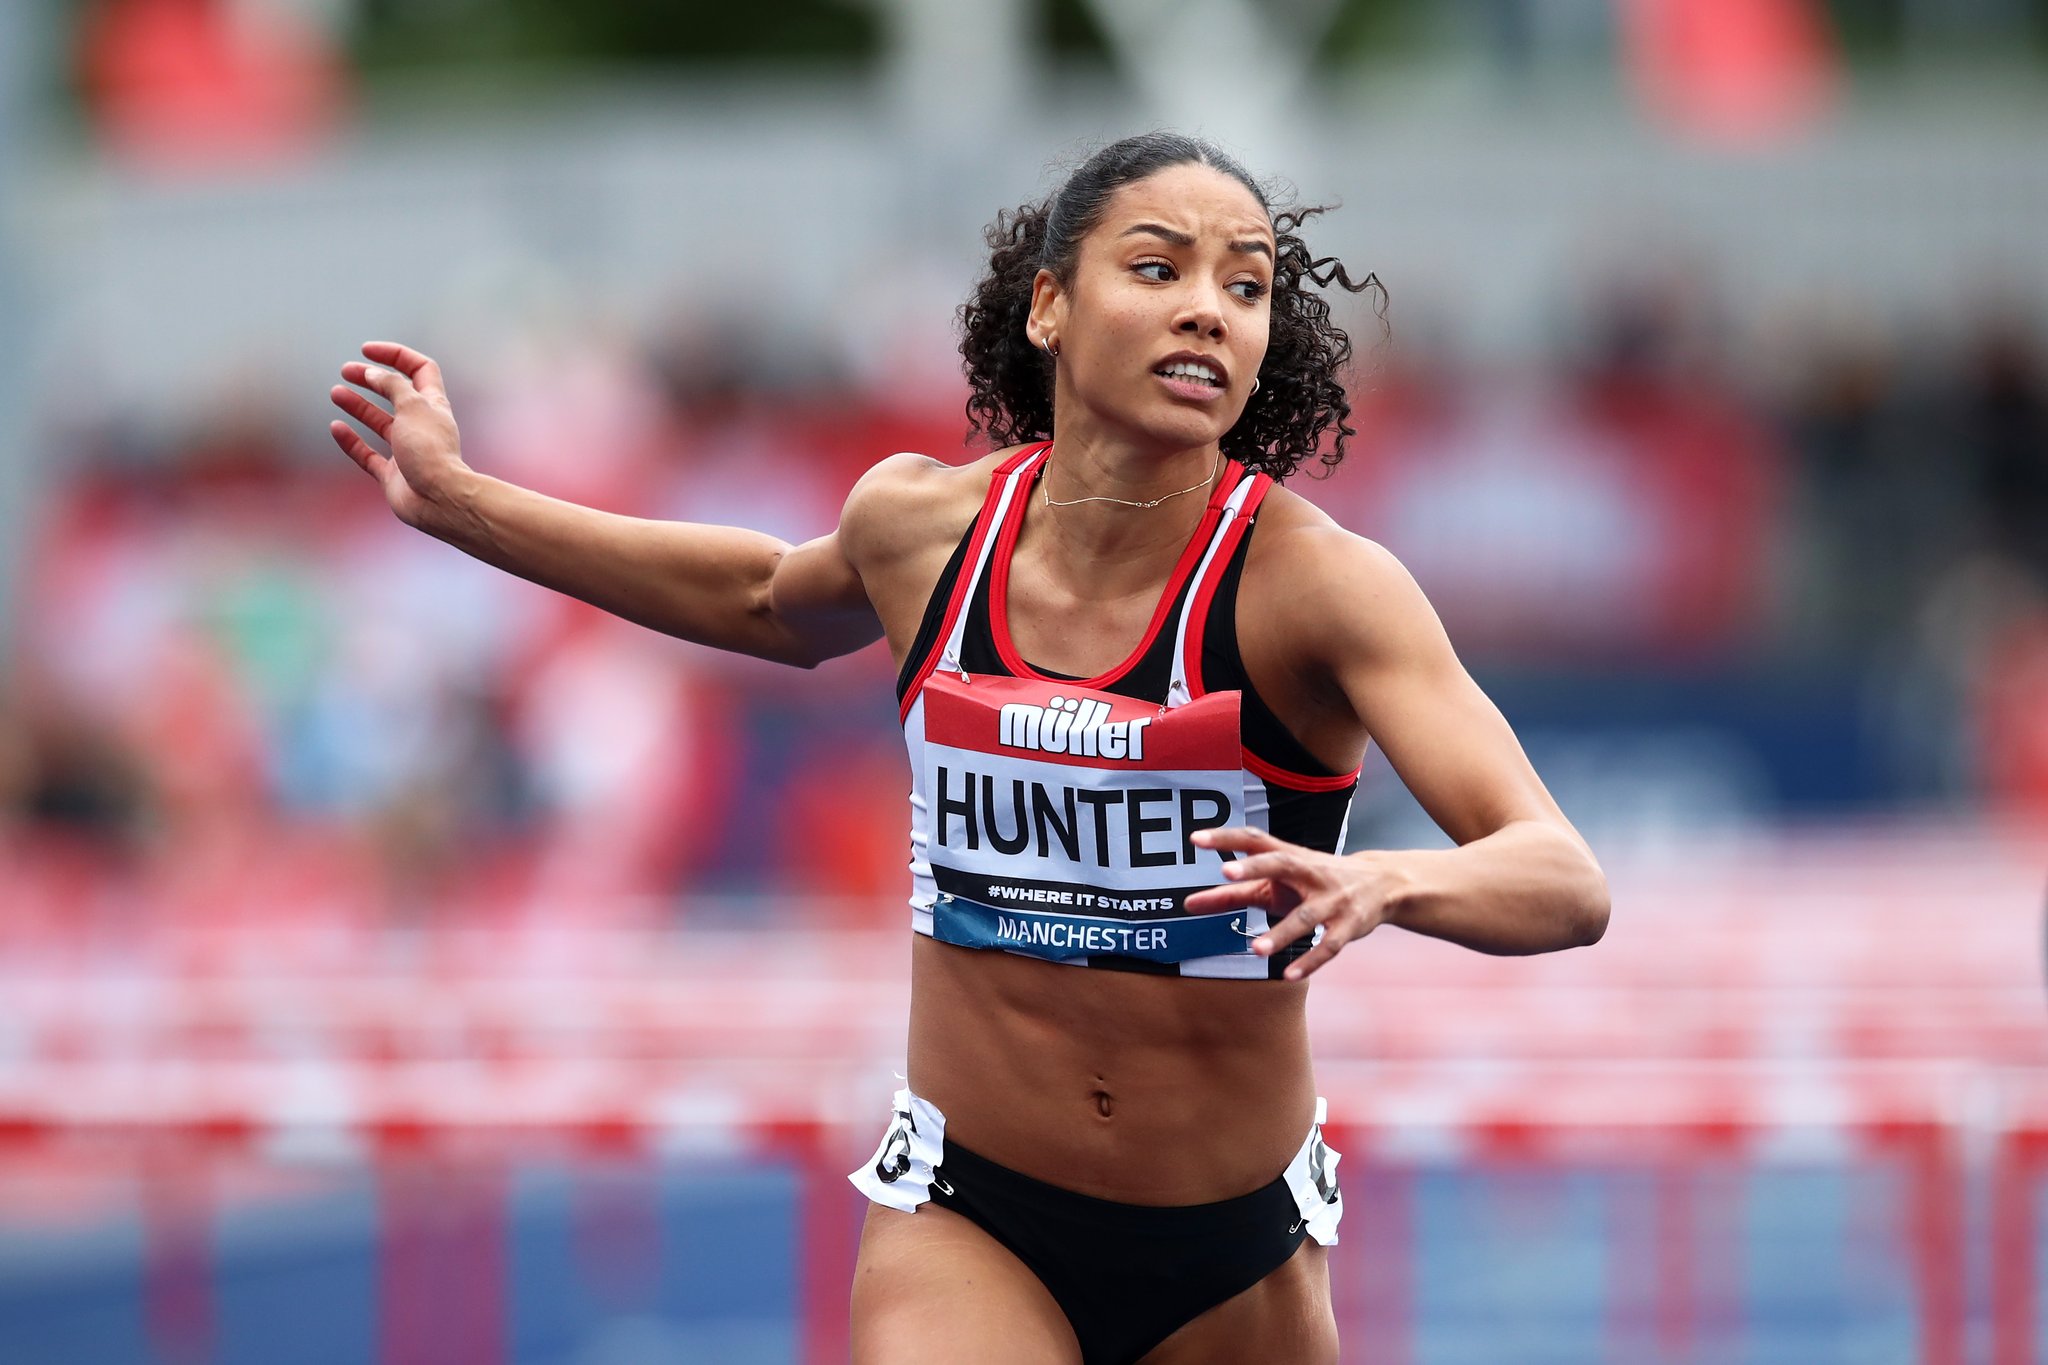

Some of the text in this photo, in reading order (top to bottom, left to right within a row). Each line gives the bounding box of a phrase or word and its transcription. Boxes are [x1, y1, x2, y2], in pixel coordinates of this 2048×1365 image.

[999, 695, 1152, 761] müller
[936, 766, 1238, 869] HUNTER
[988, 885, 1174, 912] #WHERE IT STARTS
[996, 916, 1168, 951] MANCHESTER
